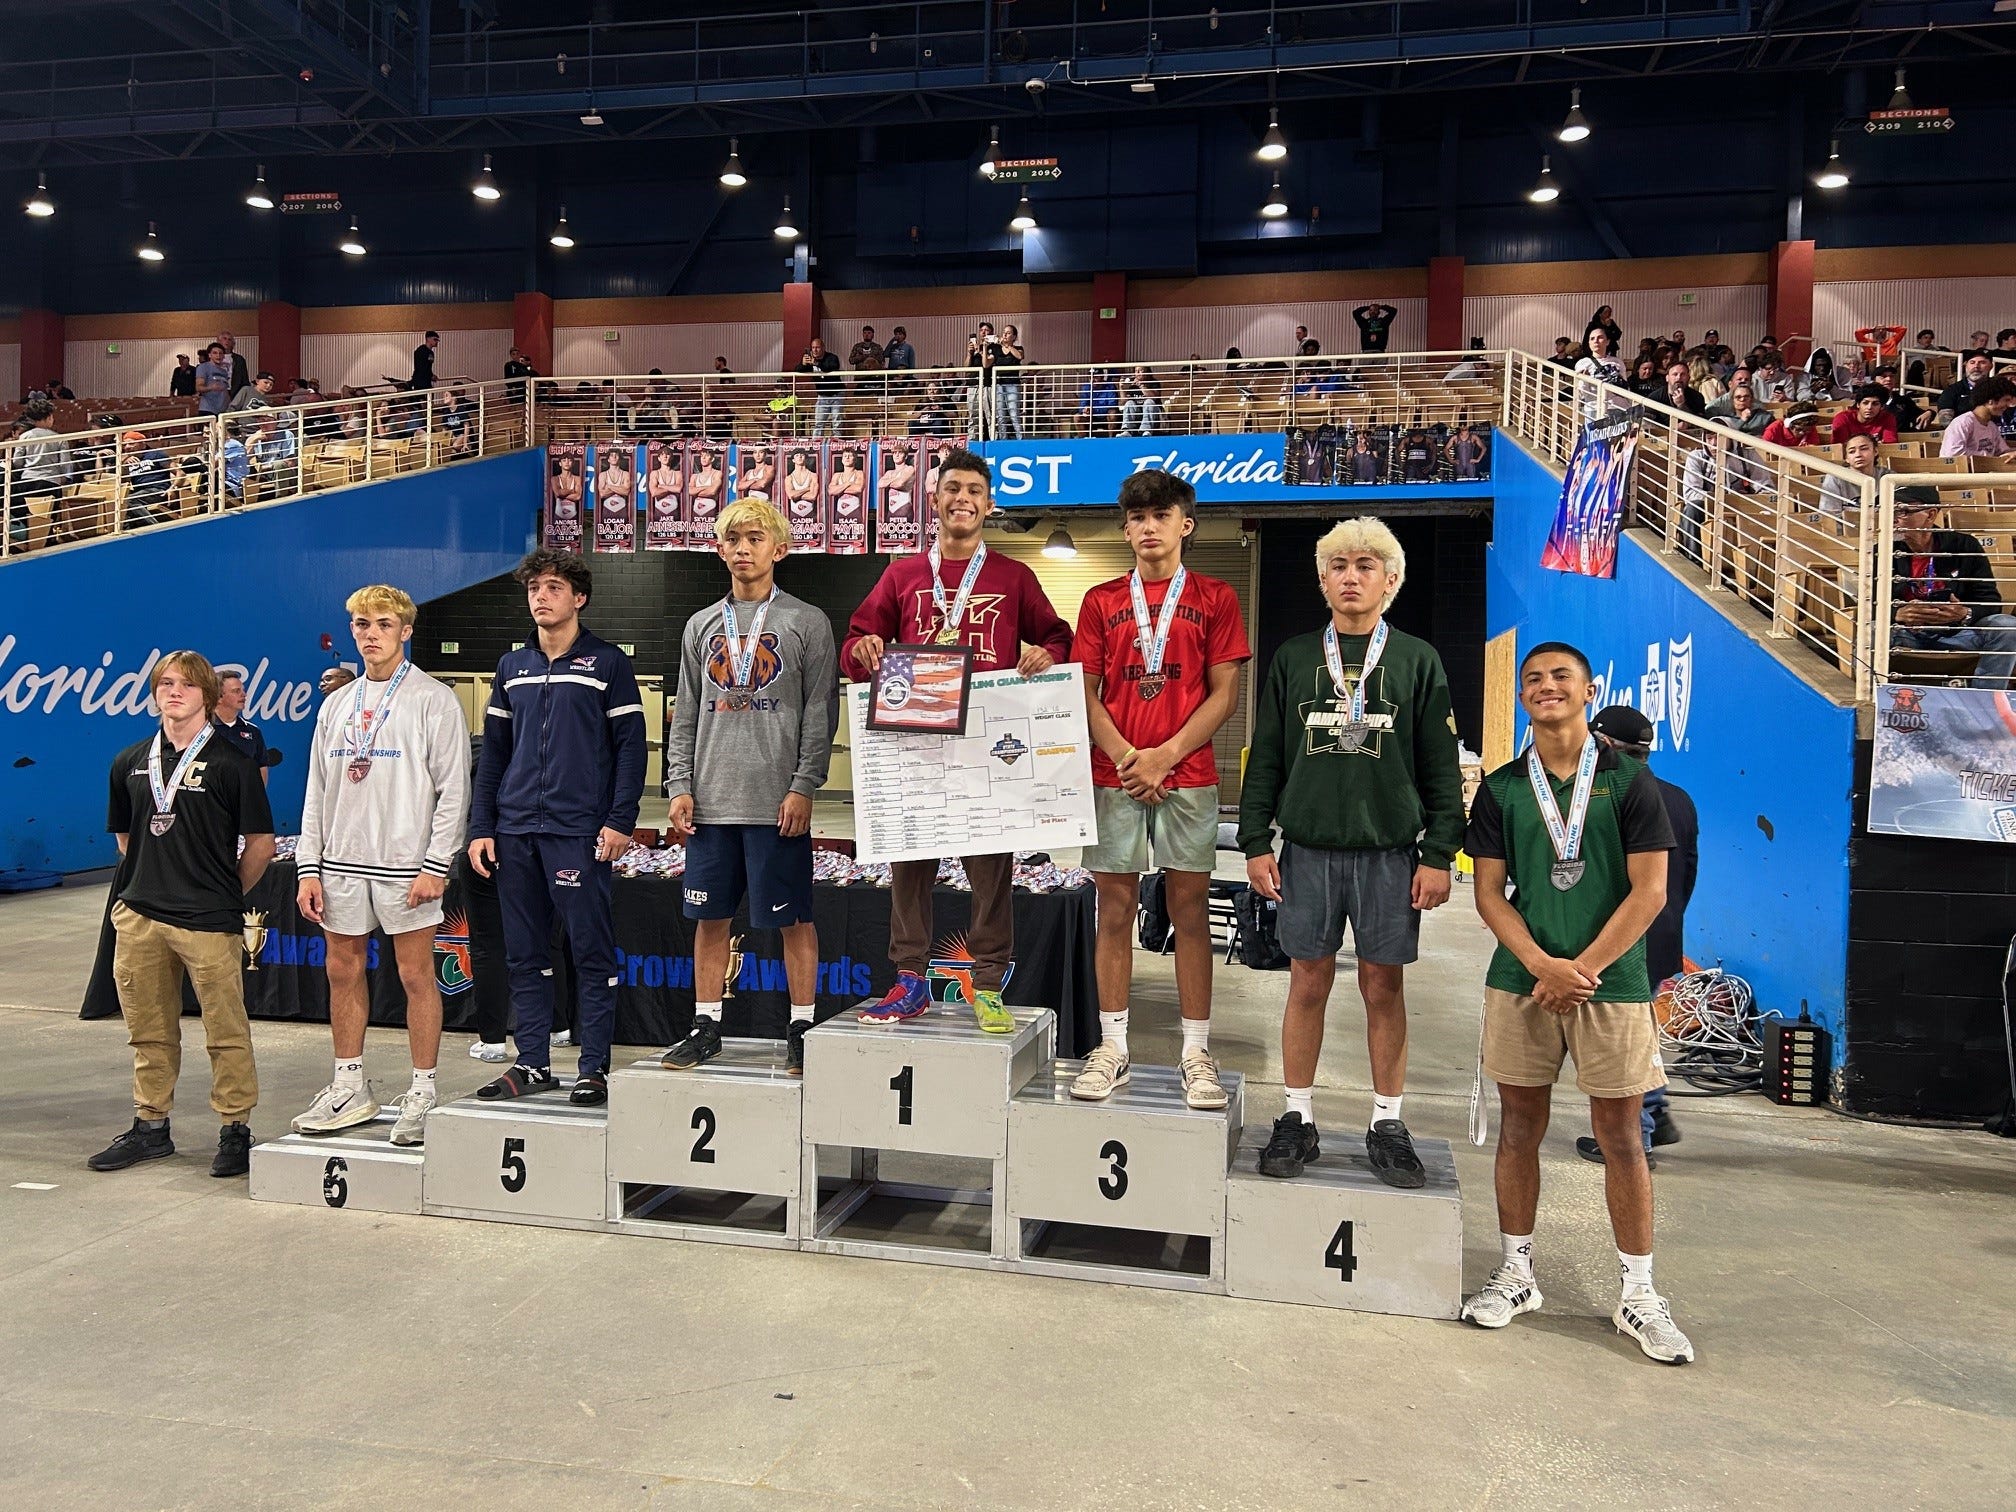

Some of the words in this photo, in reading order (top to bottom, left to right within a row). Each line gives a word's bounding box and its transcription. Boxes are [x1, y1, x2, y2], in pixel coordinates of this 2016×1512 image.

[1880, 109, 1939, 118] SECTIONS
[1000, 159, 1049, 167] SECTIONS
[1961, 491, 1971, 499] 14
[545, 524, 583, 535] GARCIA
[597, 524, 634, 535] BAJOR
[878, 522, 920, 535] MOCCO
[1980, 538, 1993, 546] 13
[1108, 607, 1137, 629] MIAM
[997, 671, 1073, 688] CHAMIONSHIPS
[707, 698, 780, 713] JONEY
[1881, 708, 1930, 731] TOROS
[181, 733, 206, 767] WRESTLING
[346, 748, 402, 758] CHIONSHIPS
[1036, 745, 1076, 756] CHAMPION
[183, 760, 208, 788] C
[1530, 757, 1549, 802] WRESTLING
[1959, 769, 2016, 803] TICKE
[1553, 861, 1585, 869] FLORIDA
[261, 927, 380, 969] Awas
[614, 946, 693, 989] Crow
[738, 952, 872, 997] Awrds
[889, 1065, 914, 1126] 1
[690, 1106, 716, 1164] 2
[500, 1137, 527, 1193] 5
[1098, 1139, 1129, 1201] 3
[323, 1156, 348, 1209] 6
[1324, 1220, 1358, 1283] 4
